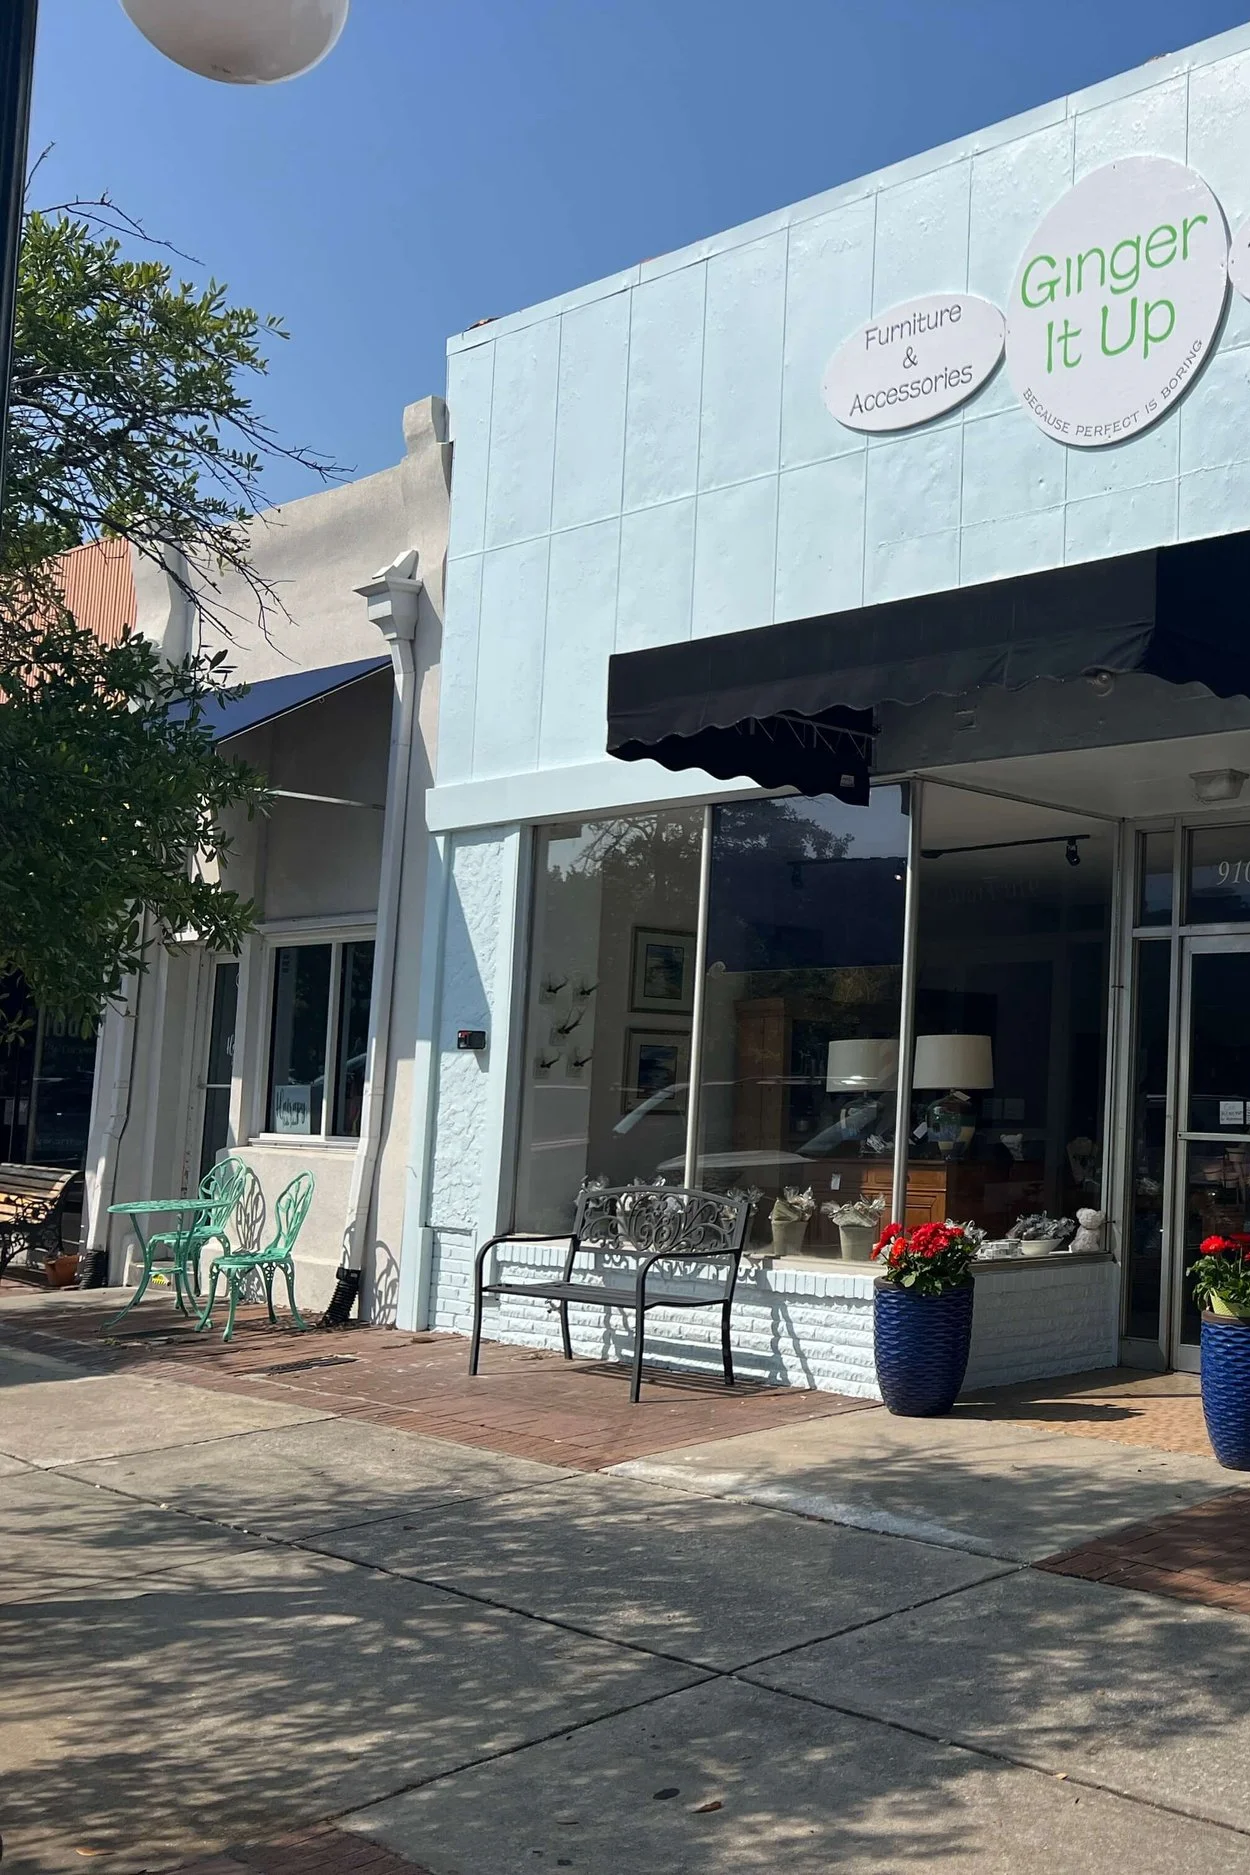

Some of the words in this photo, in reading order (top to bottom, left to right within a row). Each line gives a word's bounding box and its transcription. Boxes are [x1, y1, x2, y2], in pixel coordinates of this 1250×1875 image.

[1021, 213, 1208, 308] Ginger
[864, 304, 962, 351] Furniture
[902, 345, 919, 370] &
[1045, 321, 1082, 374] It
[1100, 297, 1176, 359] Up
[849, 364, 973, 417] Accessories
[1022, 387, 1071, 434] BECAUSE
[1075, 409, 1140, 437] PERFECT
[1145, 398, 1158, 414] IS
[1160, 339, 1202, 399] BORING
